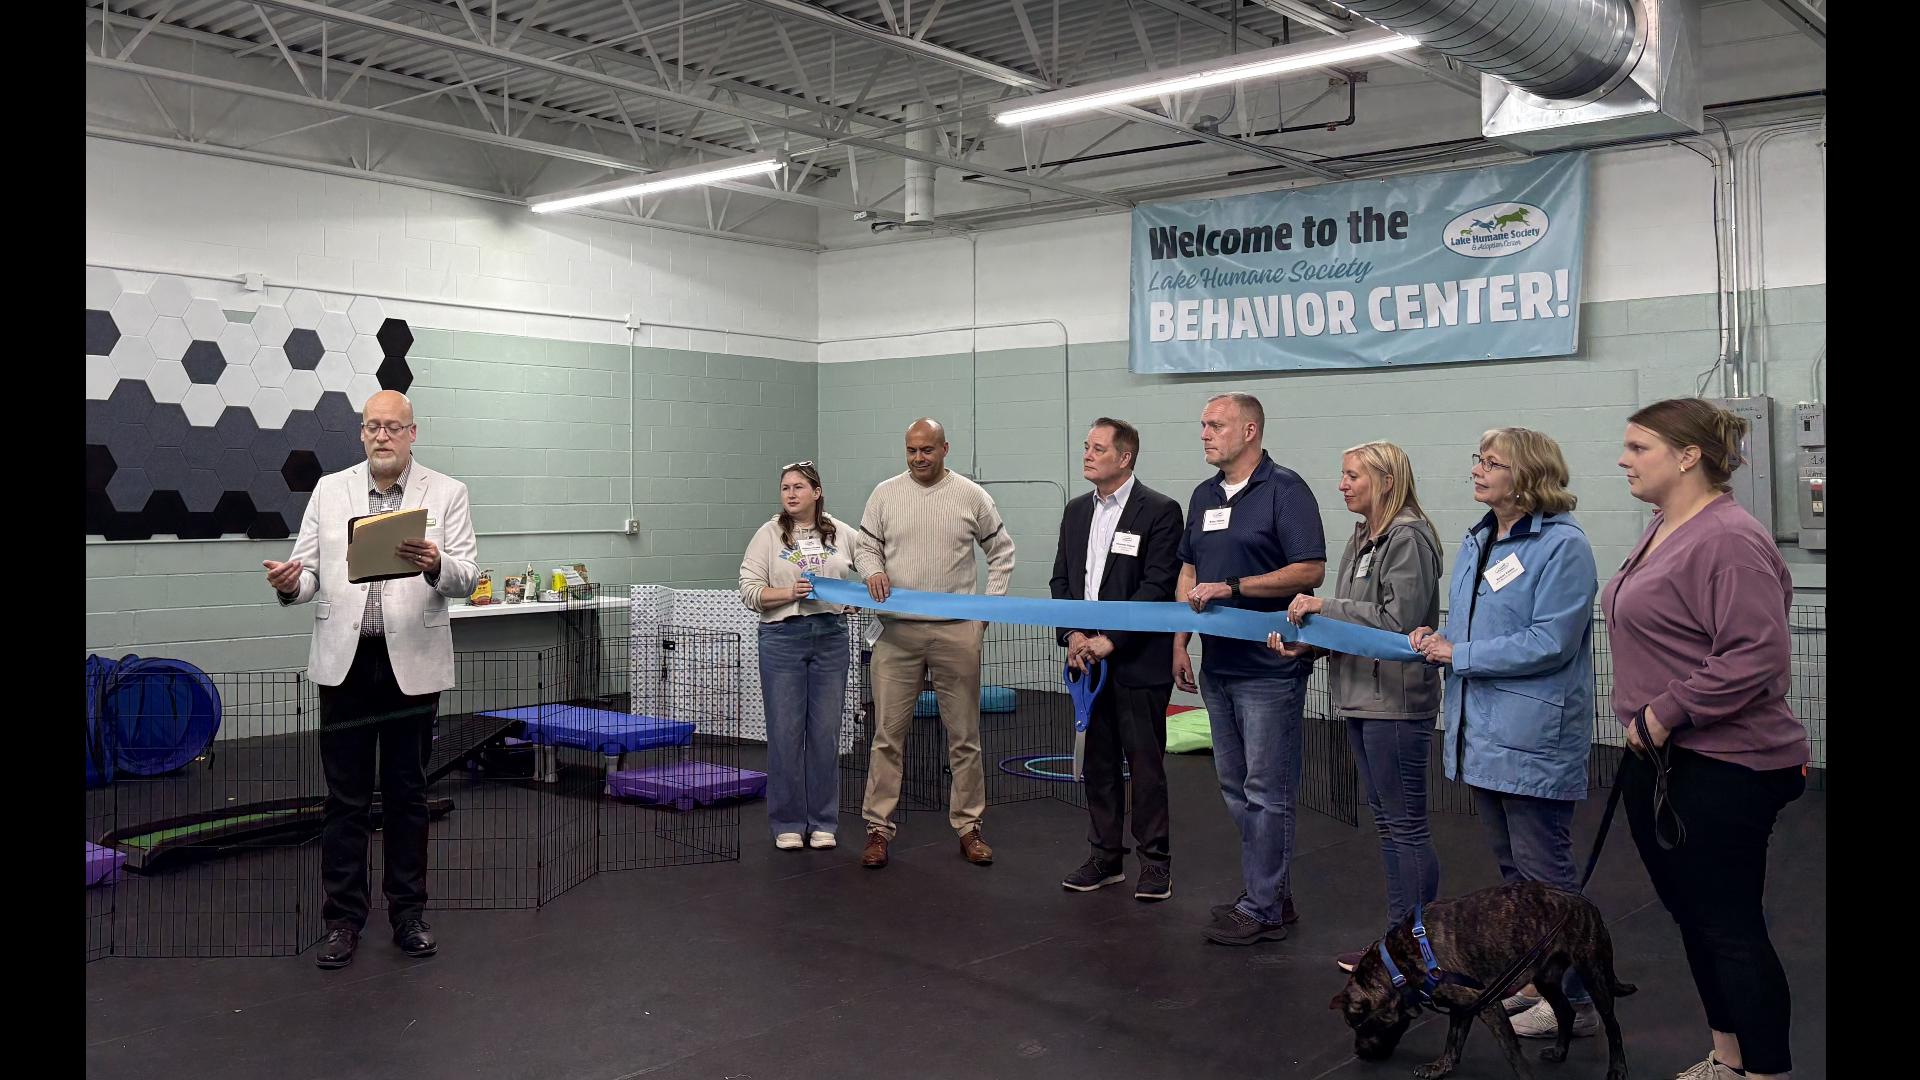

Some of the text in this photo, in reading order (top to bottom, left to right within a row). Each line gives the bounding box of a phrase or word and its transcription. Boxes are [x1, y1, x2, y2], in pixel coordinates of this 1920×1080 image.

[1149, 206, 1409, 260] Welcome to the
[1451, 228, 1540, 246] Lake Humane Society
[1148, 256, 1375, 293] Lake Humane Society
[1149, 269, 1571, 342] BEHAVIOR CENTER!
